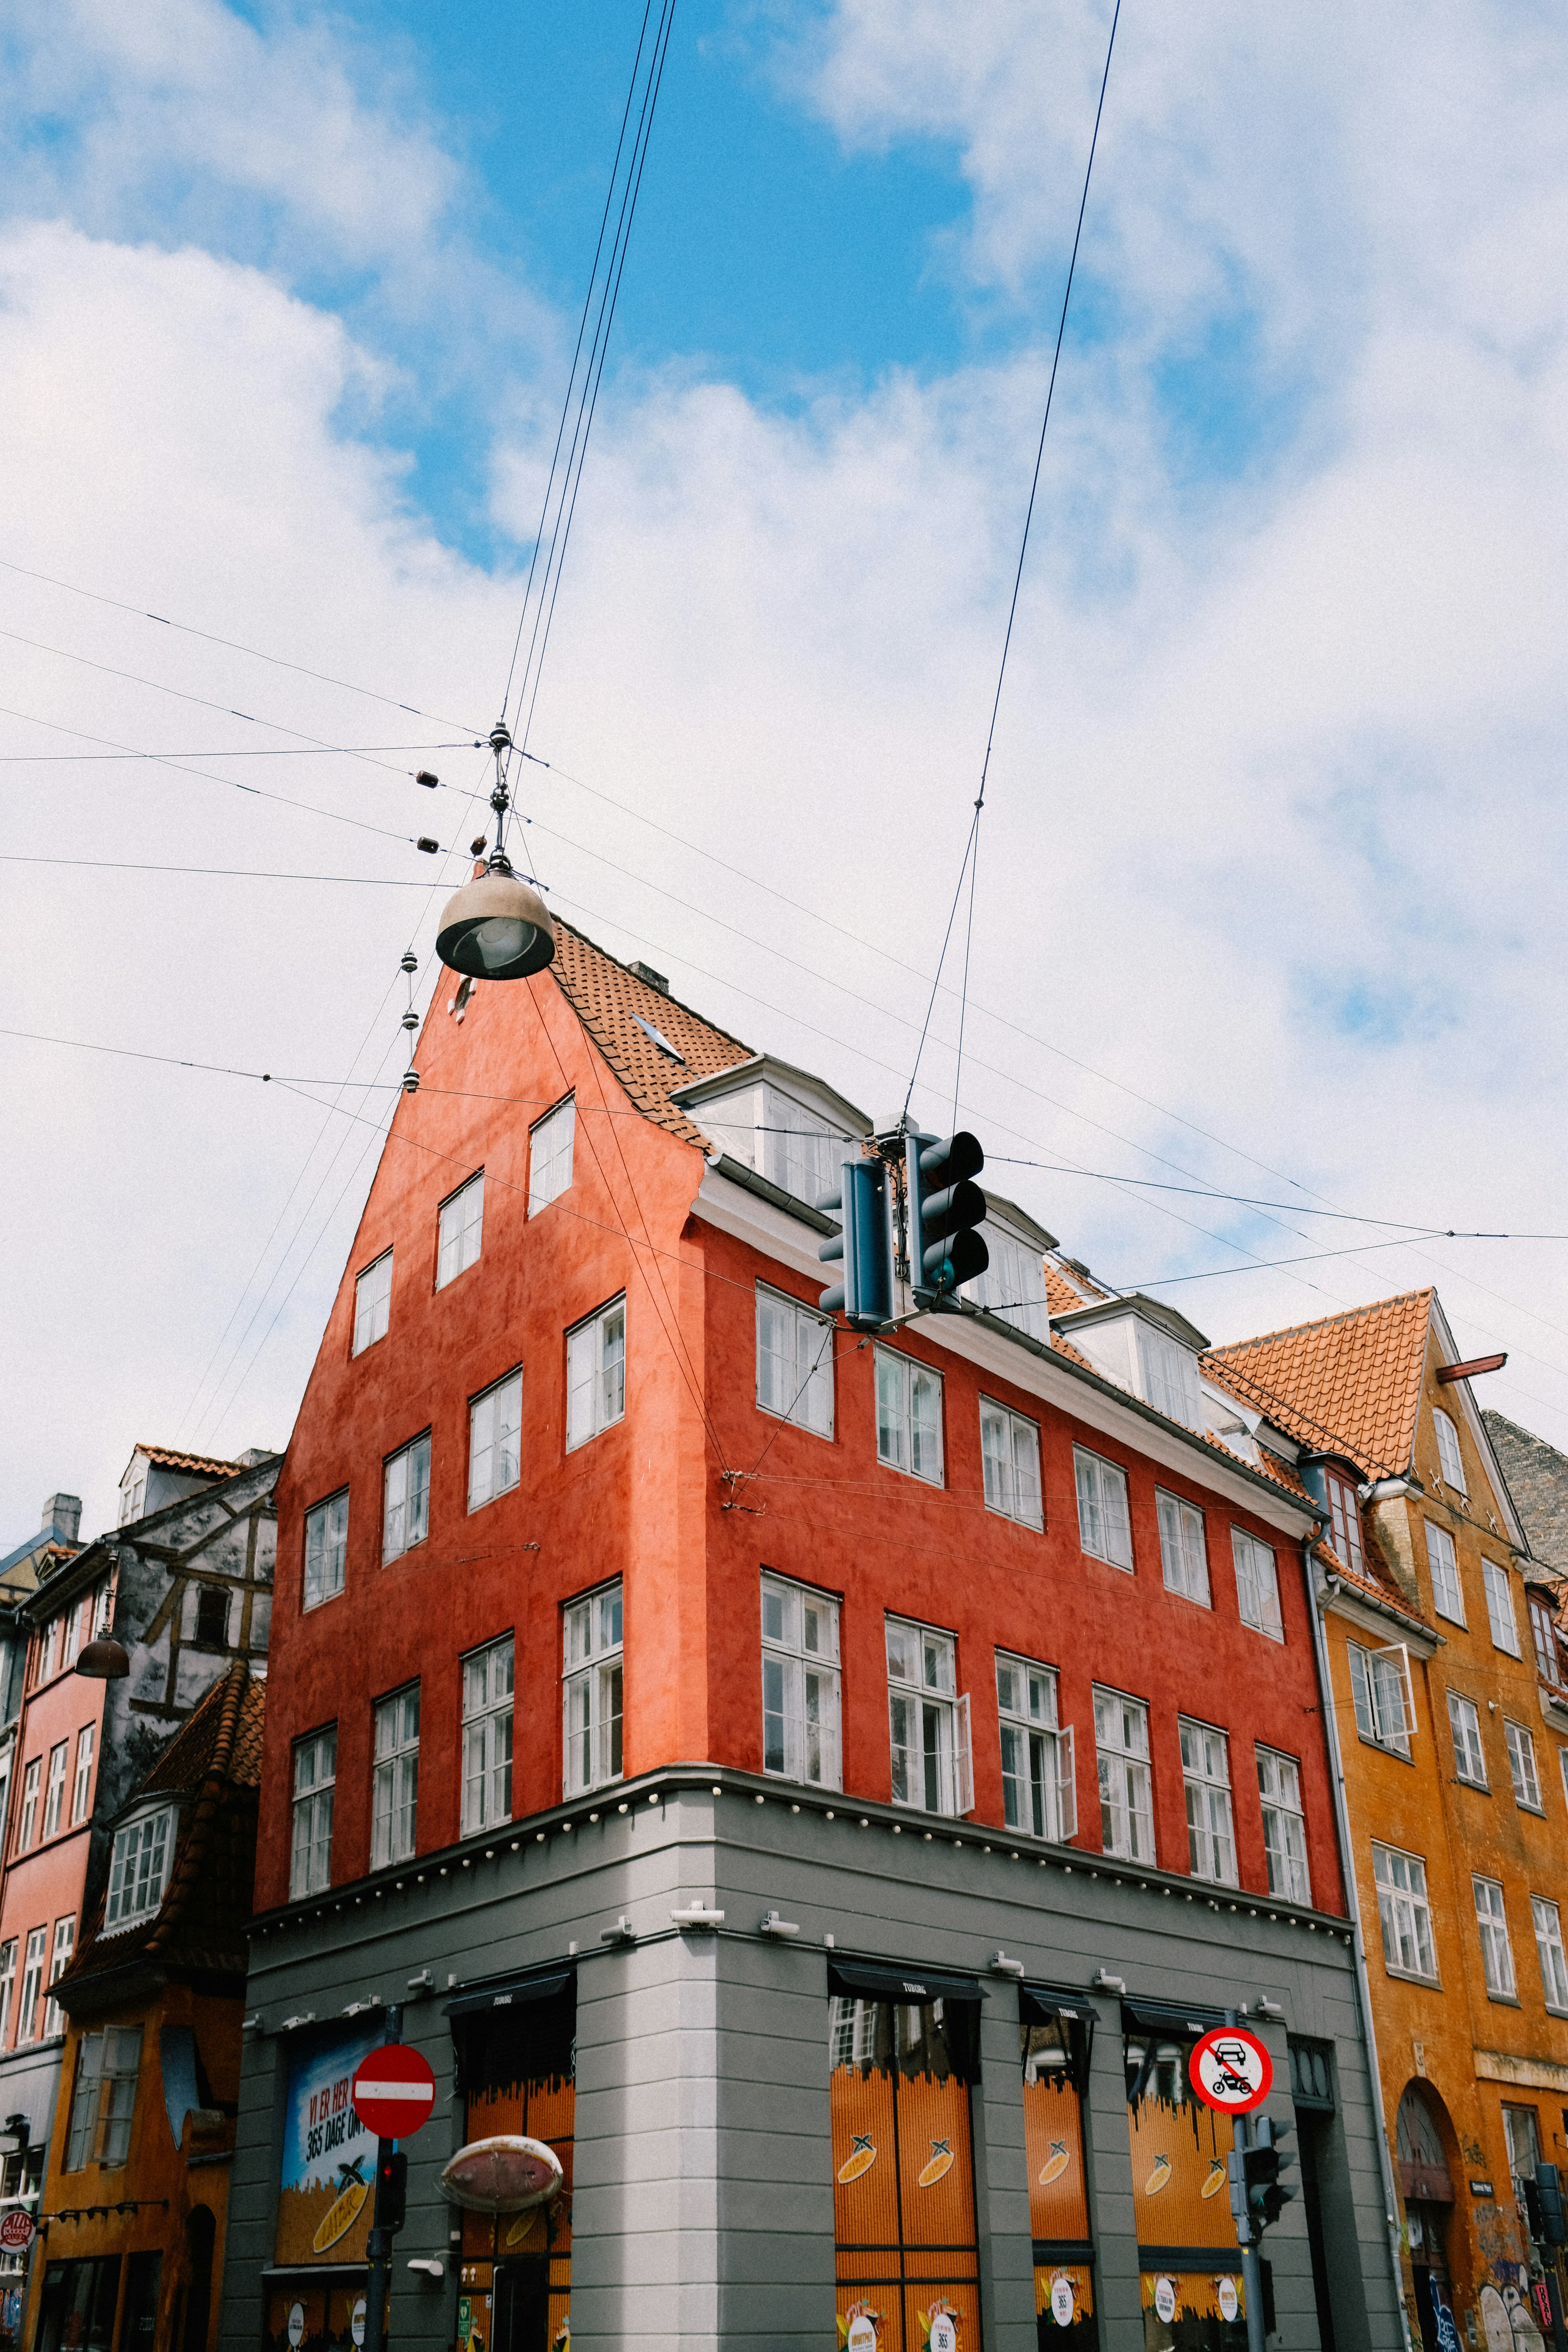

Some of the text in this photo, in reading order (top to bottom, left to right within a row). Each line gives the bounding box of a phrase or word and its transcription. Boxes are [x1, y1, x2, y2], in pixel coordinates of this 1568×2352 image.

[903, 1982, 926, 1994] TUBORG
[1058, 2007, 1078, 2019] TUBORG
[1187, 2022, 1204, 2033] TUBORG
[310, 2077, 348, 2127] VI ER HER
[307, 2108, 361, 2162] 365 DAGE OM
[1058, 2295, 1067, 2309] 365
[938, 2333, 948, 2348] 365
